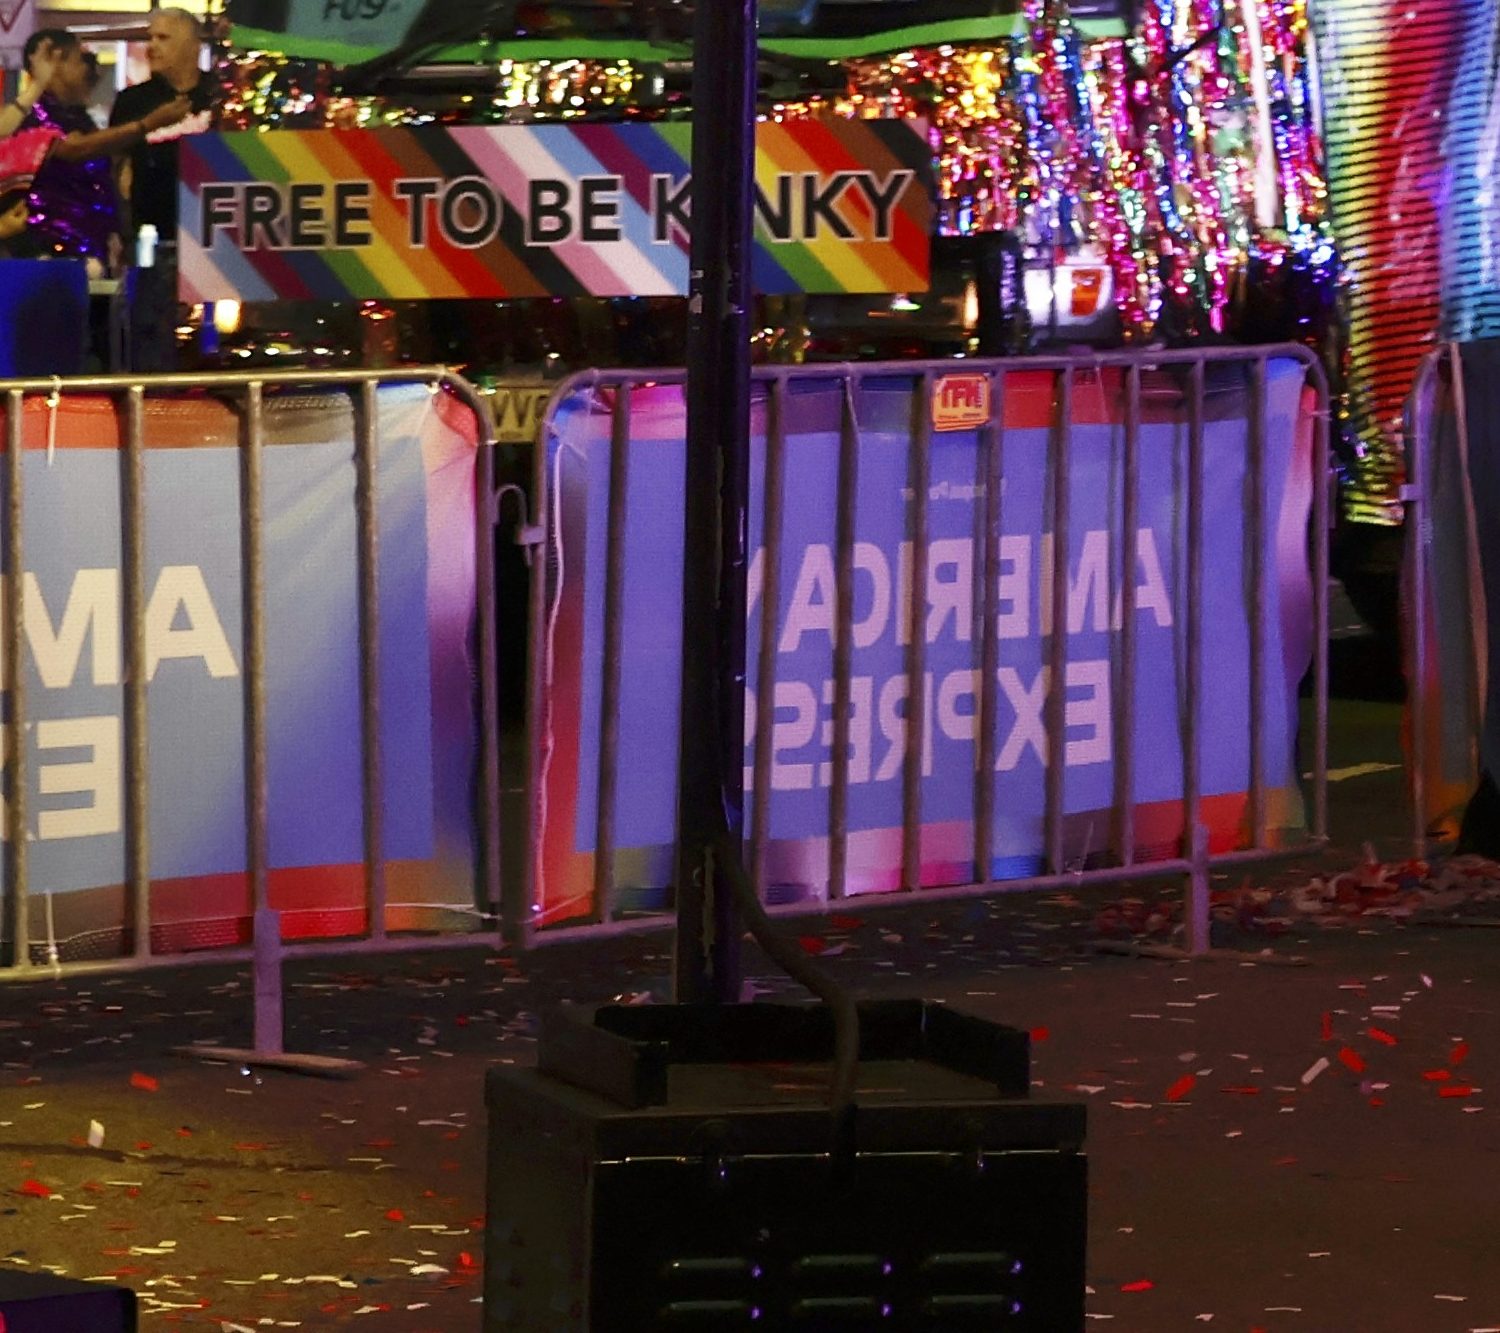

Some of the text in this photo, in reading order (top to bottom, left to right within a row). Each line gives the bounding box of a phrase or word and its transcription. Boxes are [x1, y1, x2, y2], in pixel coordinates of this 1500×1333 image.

[200, 169, 915, 252] FREE TO BE KNKY
